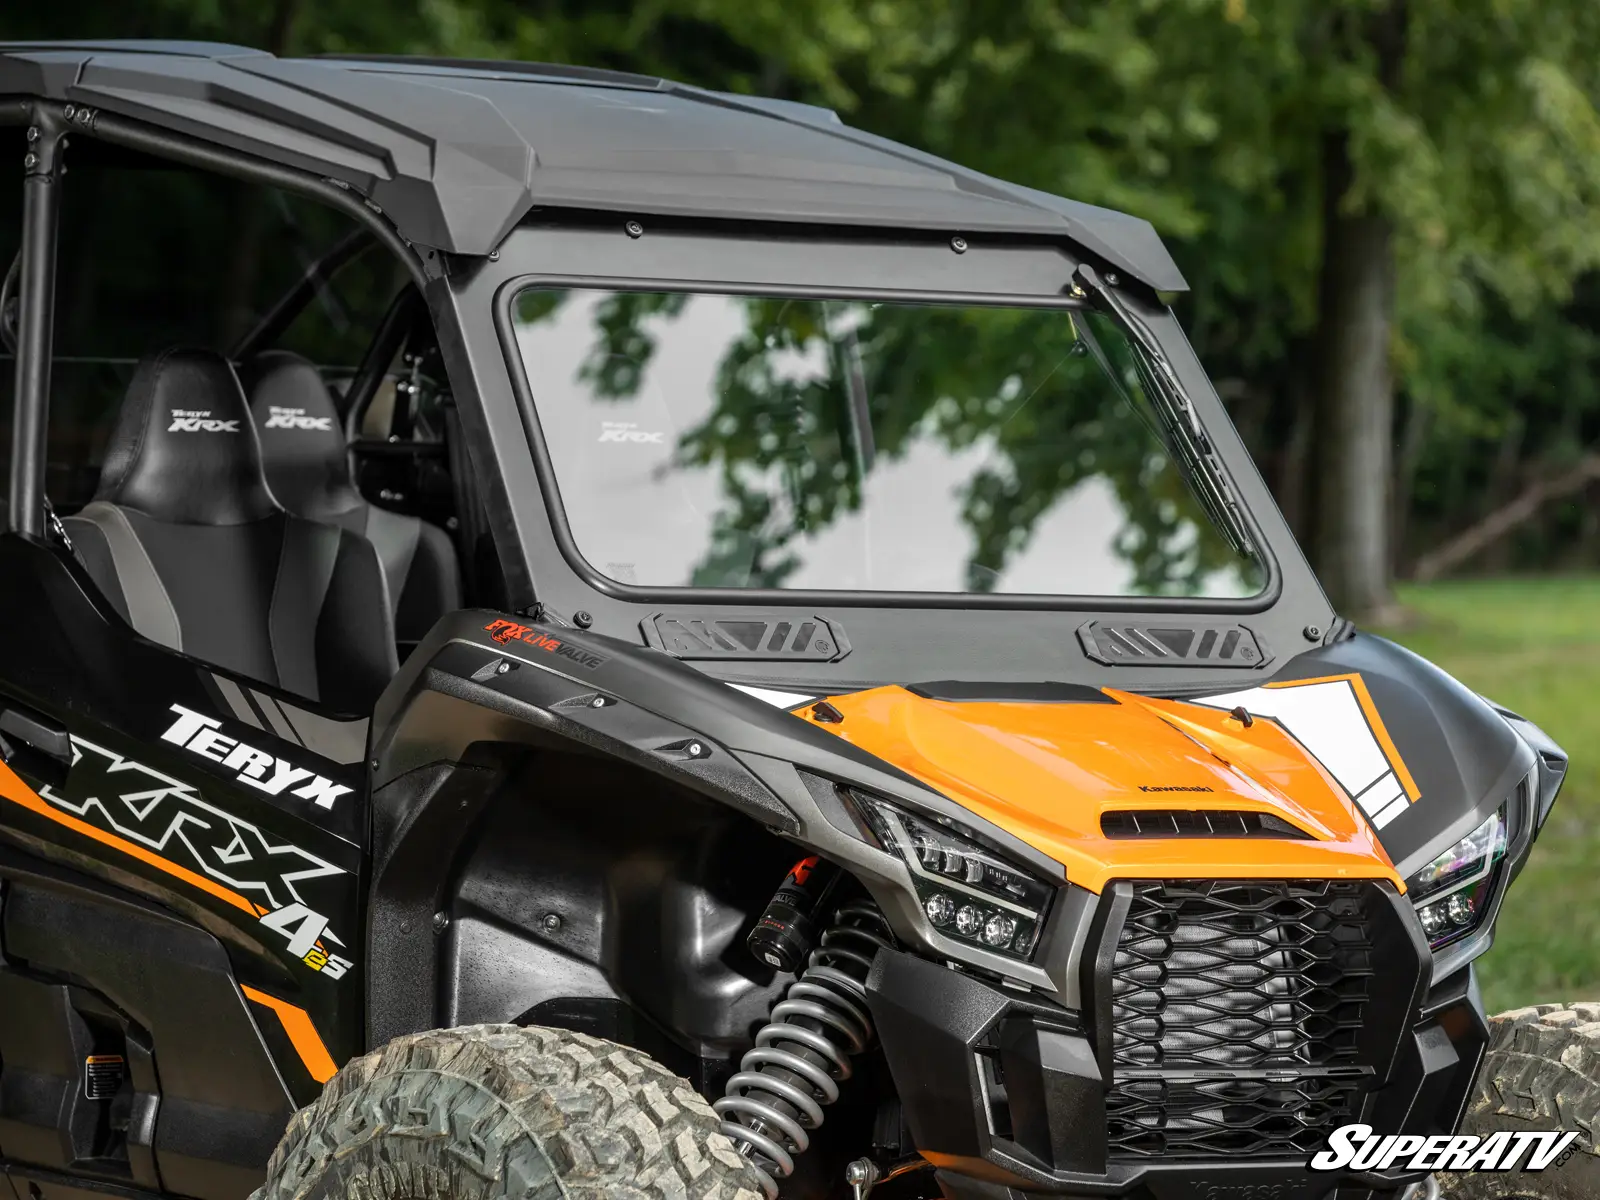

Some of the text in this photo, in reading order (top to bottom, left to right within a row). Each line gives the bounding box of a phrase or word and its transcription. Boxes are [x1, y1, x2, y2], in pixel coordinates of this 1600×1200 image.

[167, 417, 241, 432] KRX
[264, 415, 333, 431] KRX
[484, 619, 533, 645] FOX
[160, 703, 354, 811] TERYX
[38, 733, 347, 909] KRX
